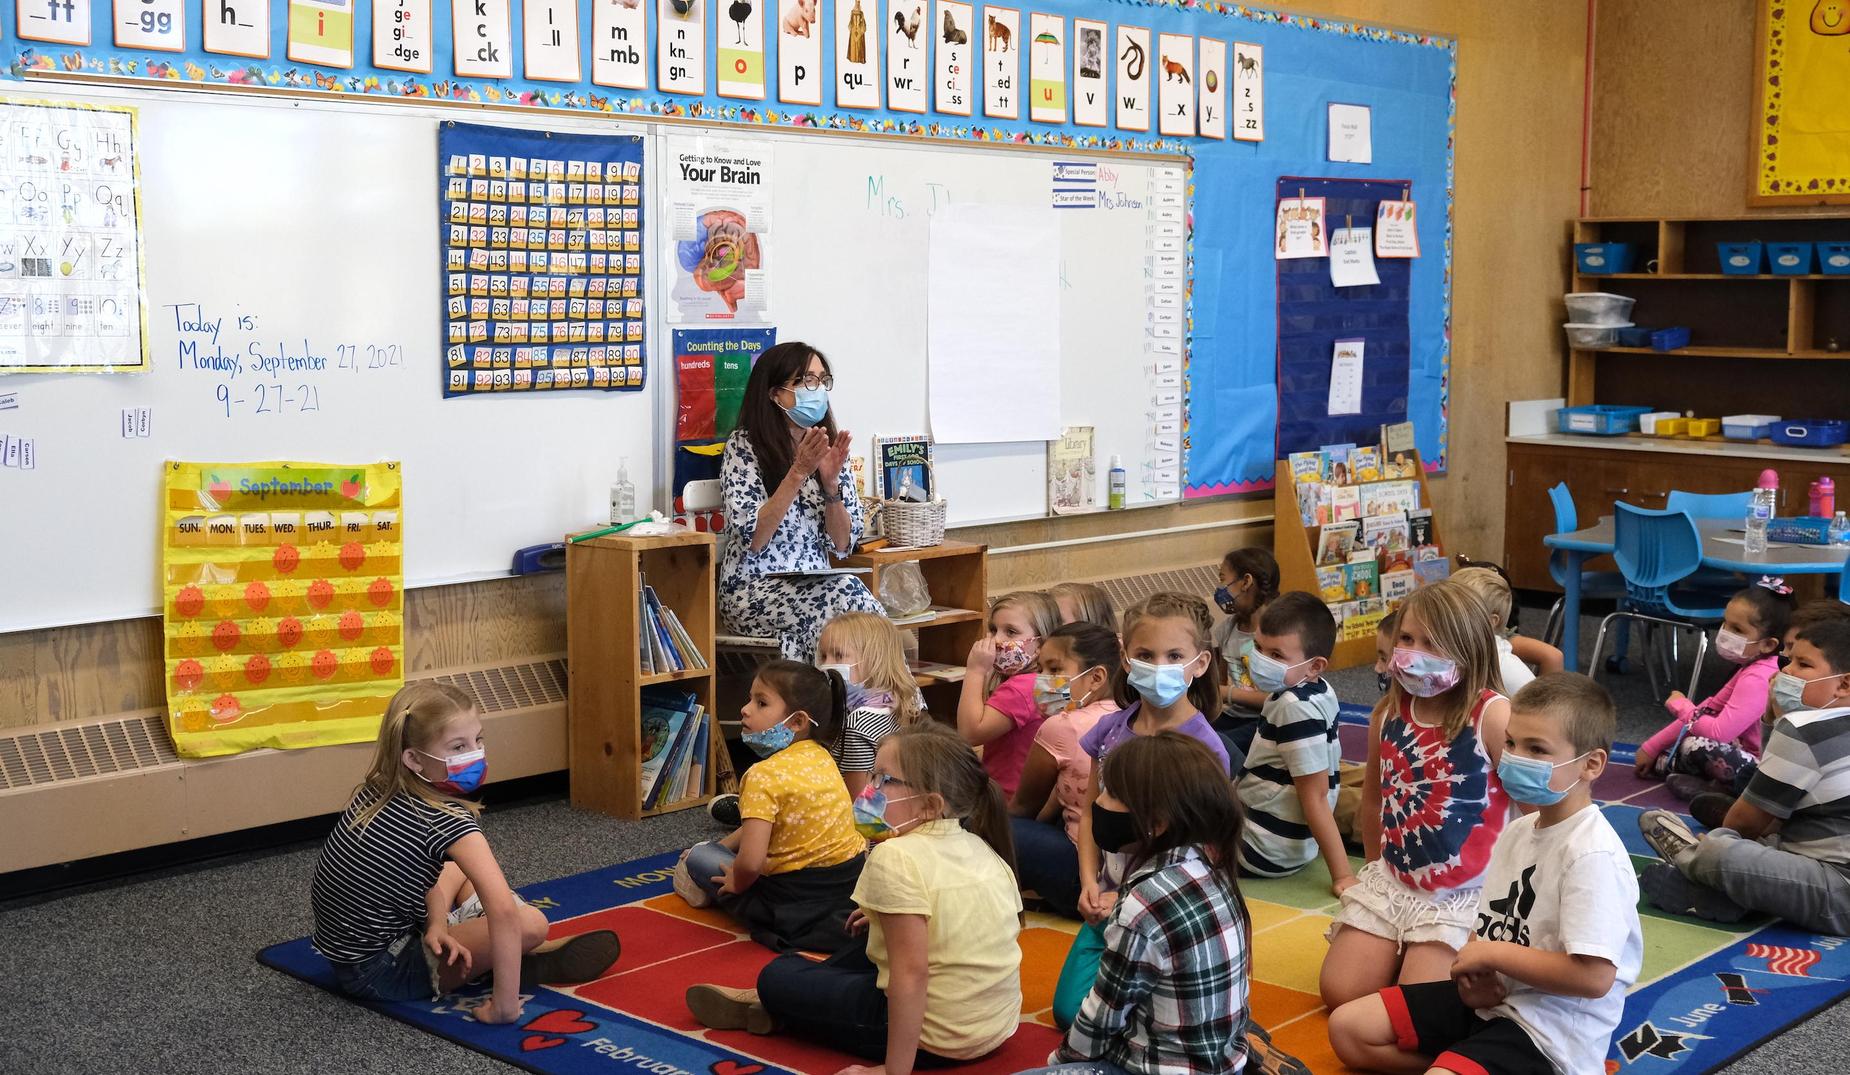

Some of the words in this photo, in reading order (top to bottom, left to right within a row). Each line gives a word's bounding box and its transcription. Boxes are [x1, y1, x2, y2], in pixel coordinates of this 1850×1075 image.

[395, 9, 411, 22] ge
[475, 0, 487, 16] k
[318, 11, 324, 36] i
[477, 23, 487, 37] c
[611, 25, 628, 41] m
[677, 27, 685, 39] n
[466, 42, 500, 62] _ck
[599, 46, 640, 64] _mb
[951, 52, 957, 62] s
[734, 58, 747, 73] o
[903, 57, 910, 69] r
[948, 63, 960, 74] ce
[998, 60, 1003, 72] t
[794, 64, 806, 85] p
[1044, 87, 1052, 101] u
[1086, 93, 1094, 105] v
[1244, 88, 1250, 98] z
[96, 131, 121, 153] Hh
[457, 158, 461, 169] 1
[475, 158, 482, 170] 2
[495, 161, 502, 174] 3
[515, 161, 522, 174] 4
[535, 162, 542, 175] 5
[553, 163, 560, 176] 6
[574, 165, 581, 177] 7
[591, 166, 597, 178] 8
[611, 165, 618, 178] 9
[628, 164, 637, 178] 10
[679, 153, 704, 165] Getting
[706, 155, 713, 164] to
[714, 156, 732, 165] Know
[733, 157, 745, 166] and
[746, 158, 761, 167] Love
[680, 163, 716, 183] Your
[720, 165, 760, 185] Brain
[1065, 168, 1080, 176] Special
[1099, 167, 1120, 189] Abby
[20, 182, 48, 201] Oo
[96, 185, 128, 217] Qq
[453, 206, 465, 219] 21
[472, 207, 485, 219] 22
[491, 209, 505, 222] 23
[512, 210, 524, 223] 24
[530, 210, 544, 223] 25
[569, 212, 583, 224] 27
[589, 212, 602, 224] 28
[608, 212, 620, 225] 29
[624, 212, 637, 225] 30
[24, 235, 49, 256] Xx
[62, 237, 86, 268] Yy
[100, 238, 123, 258] Zz
[450, 255, 462, 266] 41
[471, 252, 487, 266] 42
[491, 255, 506, 267] 43
[531, 255, 546, 267] 45
[570, 257, 585, 269] 47
[591, 257, 604, 269] 48
[609, 258, 622, 271] 49
[626, 257, 639, 269] 50
[451, 299, 463, 310] 61
[472, 302, 487, 314] 62
[493, 303, 508, 316] 63
[513, 302, 526, 315] 64
[531, 303, 545, 316] 65
[551, 302, 565, 315] 66
[571, 302, 584, 313] 67
[589, 303, 601, 315] 68
[608, 302, 621, 314] 69
[628, 301, 641, 313] 70
[32, 321, 54, 335] eight
[162, 303, 222, 345] Today
[237, 303, 260, 331] is:
[686, 341, 724, 352] Counting
[725, 340, 738, 351] the
[741, 340, 761, 352] Days
[179, 339, 243, 379] Monday,
[248, 338, 328, 378] September
[337, 344, 359, 373] 27,
[366, 344, 404, 369] 2021
[680, 360, 711, 370] hundreds
[724, 361, 739, 370] tens
[887, 443, 924, 457] EMILY'S
[240, 476, 335, 500] September
[179, 523, 201, 533] SUN.
[209, 523, 235, 534] MON.
[244, 523, 267, 534] TUES.
[274, 523, 296, 533] WED.
[307, 520, 334, 533] THUR.
[347, 522, 361, 532] FRI.
[377, 521, 393, 531] SAT.
[1669, 1001, 1727, 1030] June
